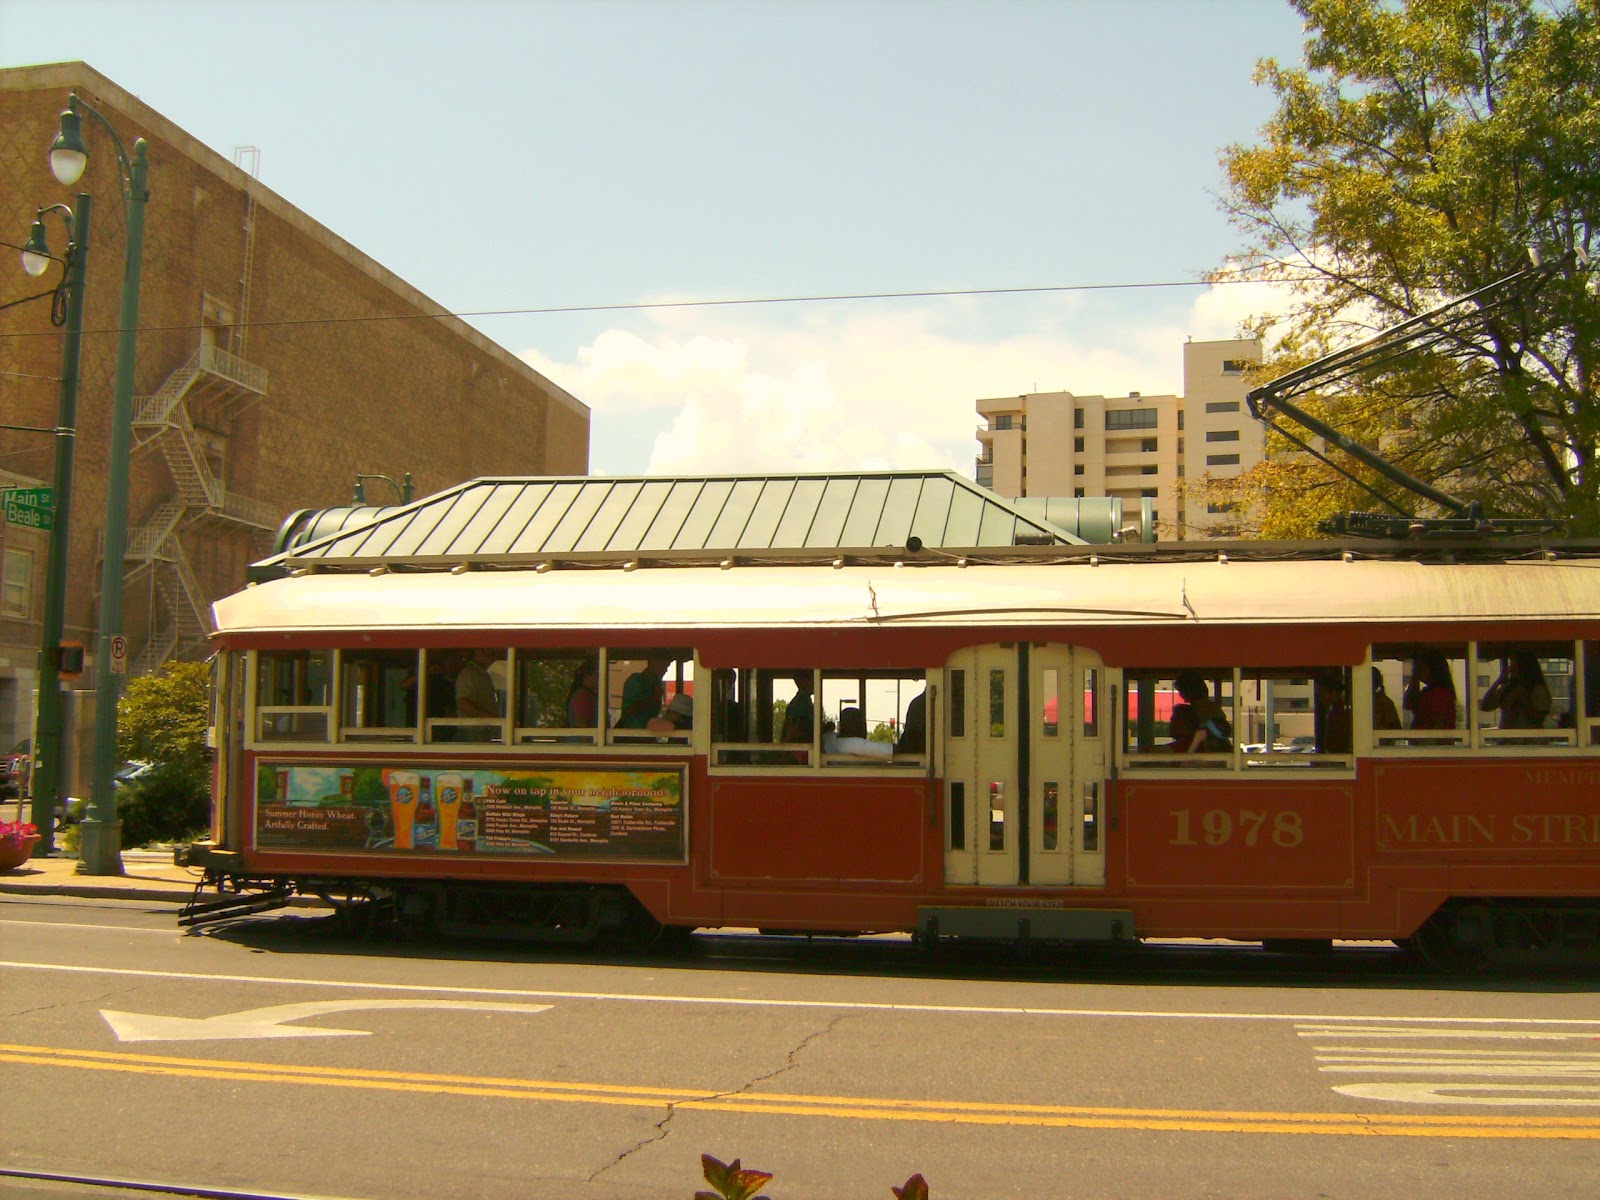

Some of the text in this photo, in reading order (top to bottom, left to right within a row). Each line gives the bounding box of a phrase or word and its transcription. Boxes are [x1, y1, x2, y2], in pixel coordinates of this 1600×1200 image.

[5, 491, 37, 509] Main
[9, 503, 40, 526] Beale
[487, 784, 510, 794] Now
[530, 787, 546, 797] tap
[550, 786, 559, 795] in
[562, 788, 586, 797] your
[265, 809, 356, 819] Summer Honey Wheat.
[265, 820, 328, 830] Artfully Crafted.
[1168, 808, 1304, 848] 1978
[1382, 813, 1497, 843] MAIN
[988, 899, 1017, 907] WATCH
[1019, 899, 1040, 908] YOUR
